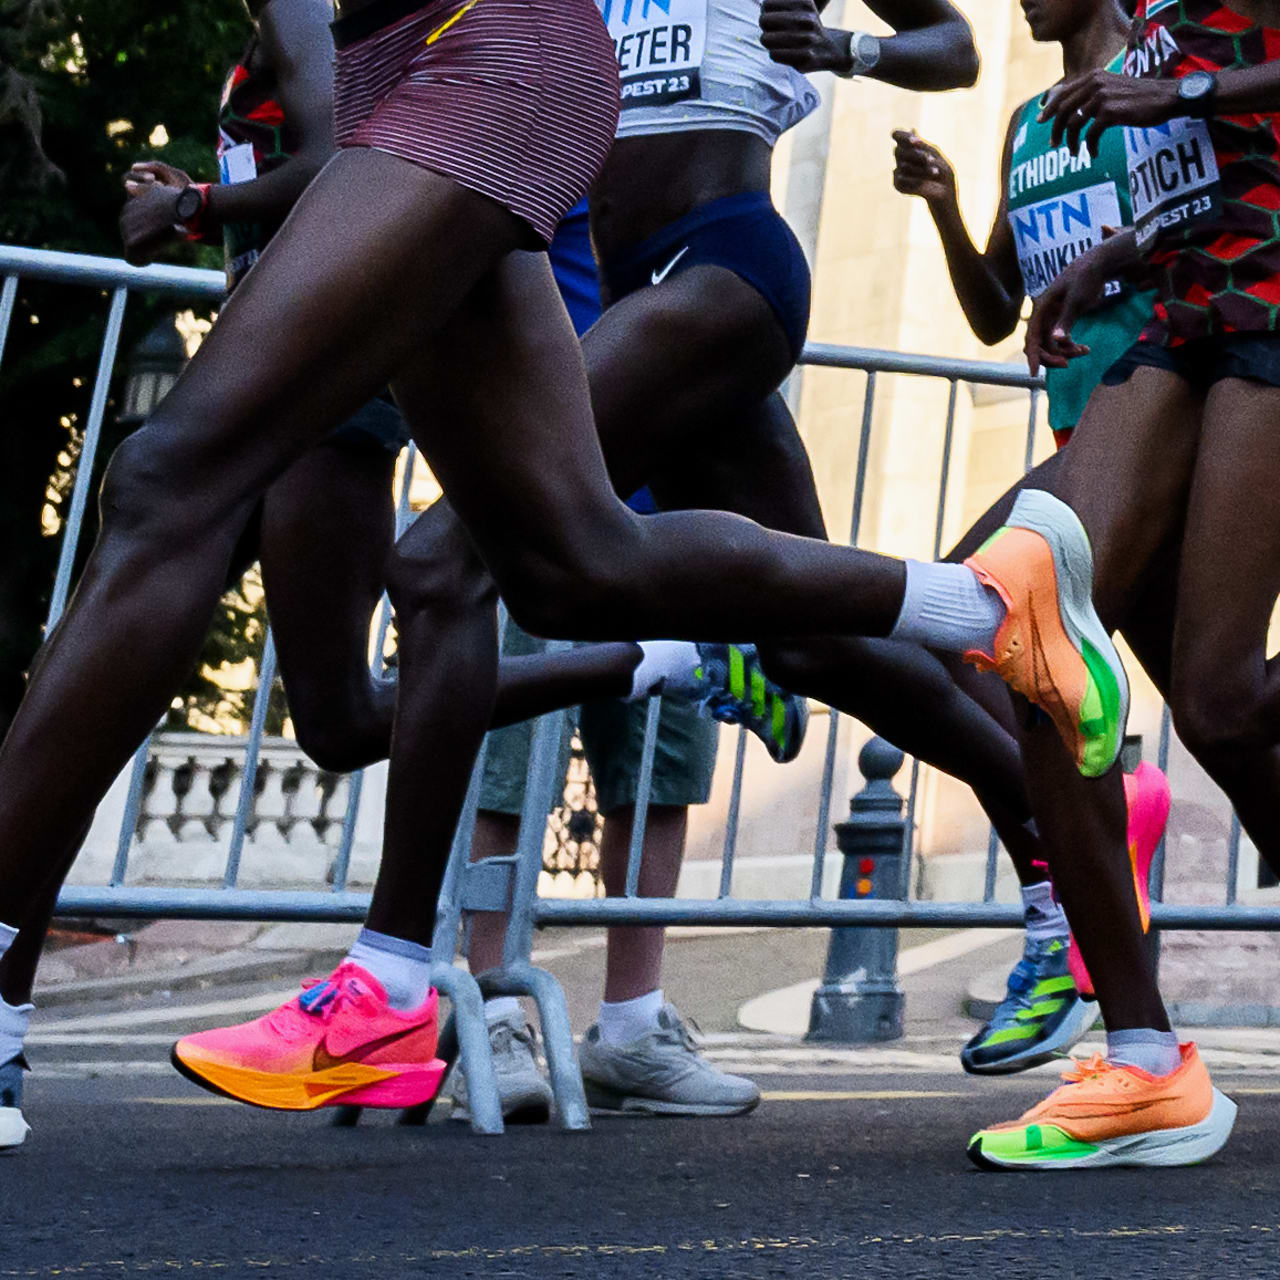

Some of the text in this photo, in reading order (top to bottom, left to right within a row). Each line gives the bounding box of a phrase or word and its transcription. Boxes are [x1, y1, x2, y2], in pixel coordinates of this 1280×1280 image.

[613, 23, 692, 71] ETER
[621, 75, 690, 99] PEST 23
[1129, 137, 1206, 214] PTICH
[1015, 193, 1092, 248] NTN
[1192, 194, 1213, 216] 23
[1103, 280, 1122, 297] 23
